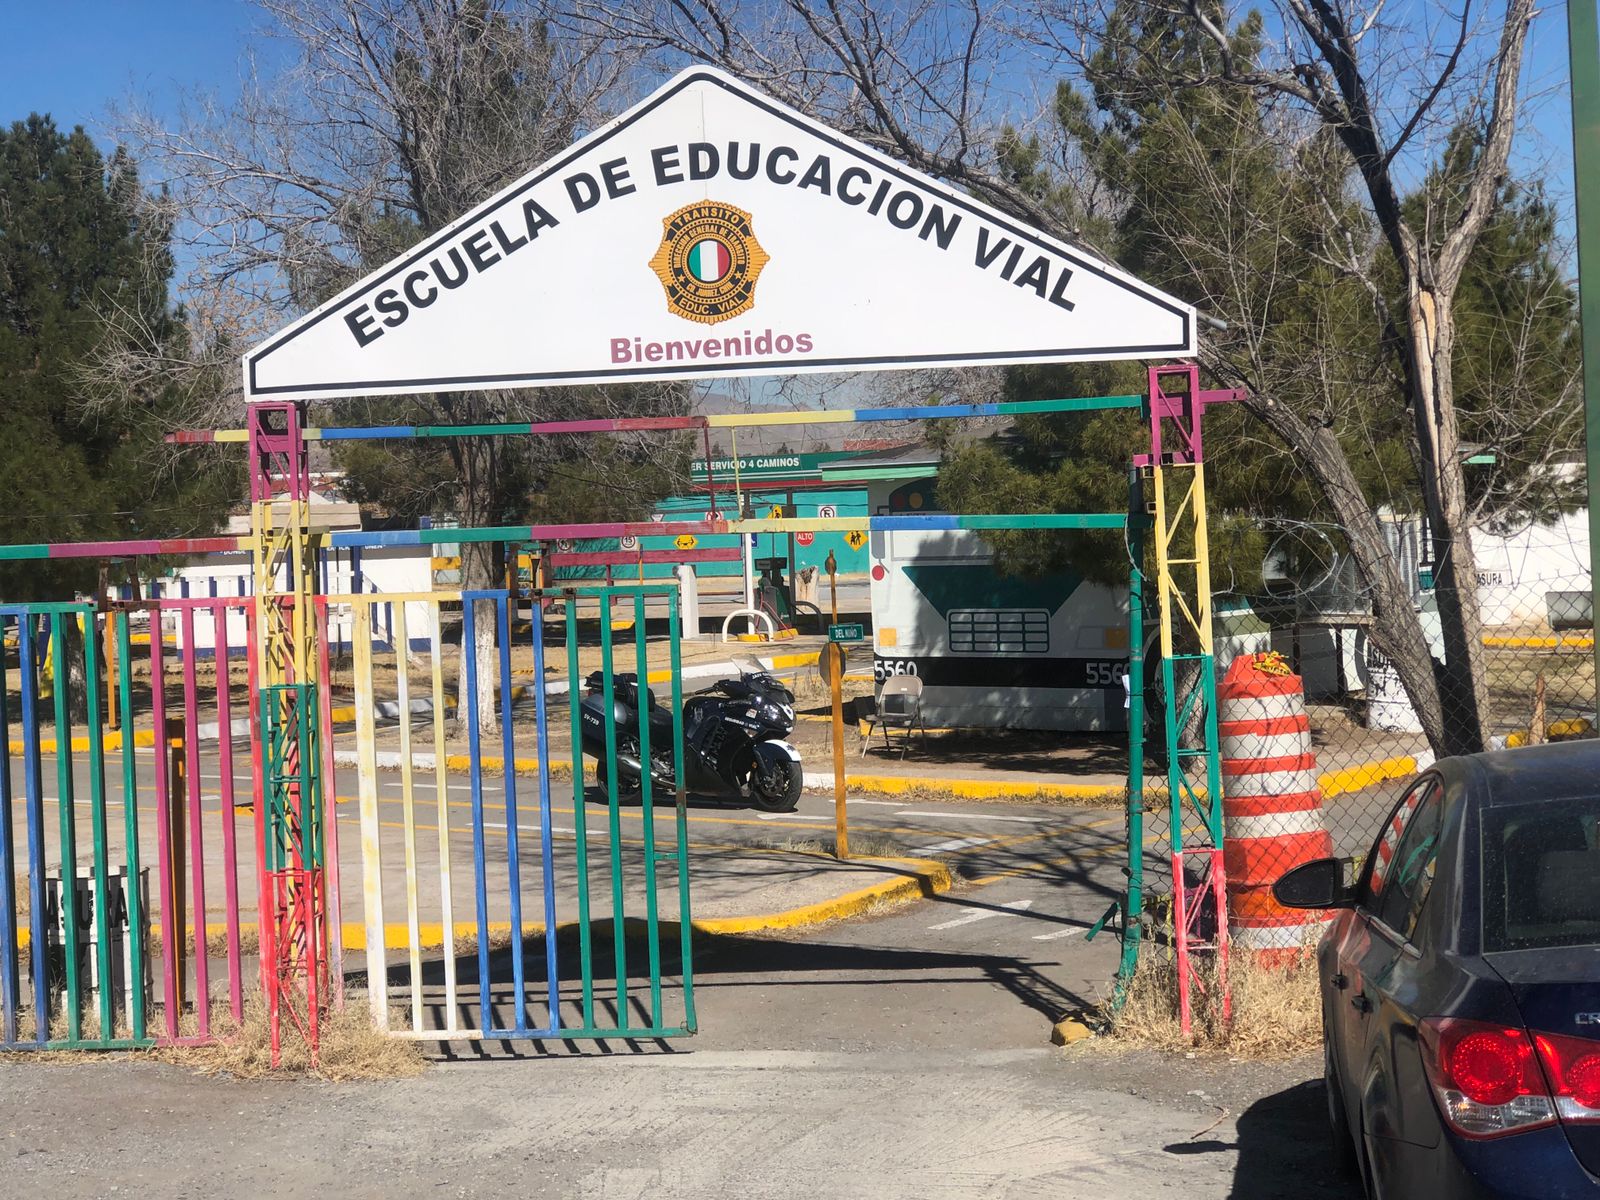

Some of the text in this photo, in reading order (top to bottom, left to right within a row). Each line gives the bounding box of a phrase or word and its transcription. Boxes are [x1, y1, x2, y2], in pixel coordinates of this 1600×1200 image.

[674, 207, 740, 227] TRANSITO
[689, 225, 718, 238] GENERAL
[719, 227, 729, 237] DE
[343, 141, 1078, 349] ESCUELA DE EDUCACION VIAL
[678, 296, 744, 314] EDUC. VIAL
[610, 328, 814, 365] Bienvenidos
[749, 459, 755, 468] 4
[756, 457, 800, 468] CAMINOS
[797, 532, 813, 540] ALTO
[1476, 572, 1503, 586] ASURA
[835, 628, 845, 639] DEL
[874, 660, 918, 681] 5560
